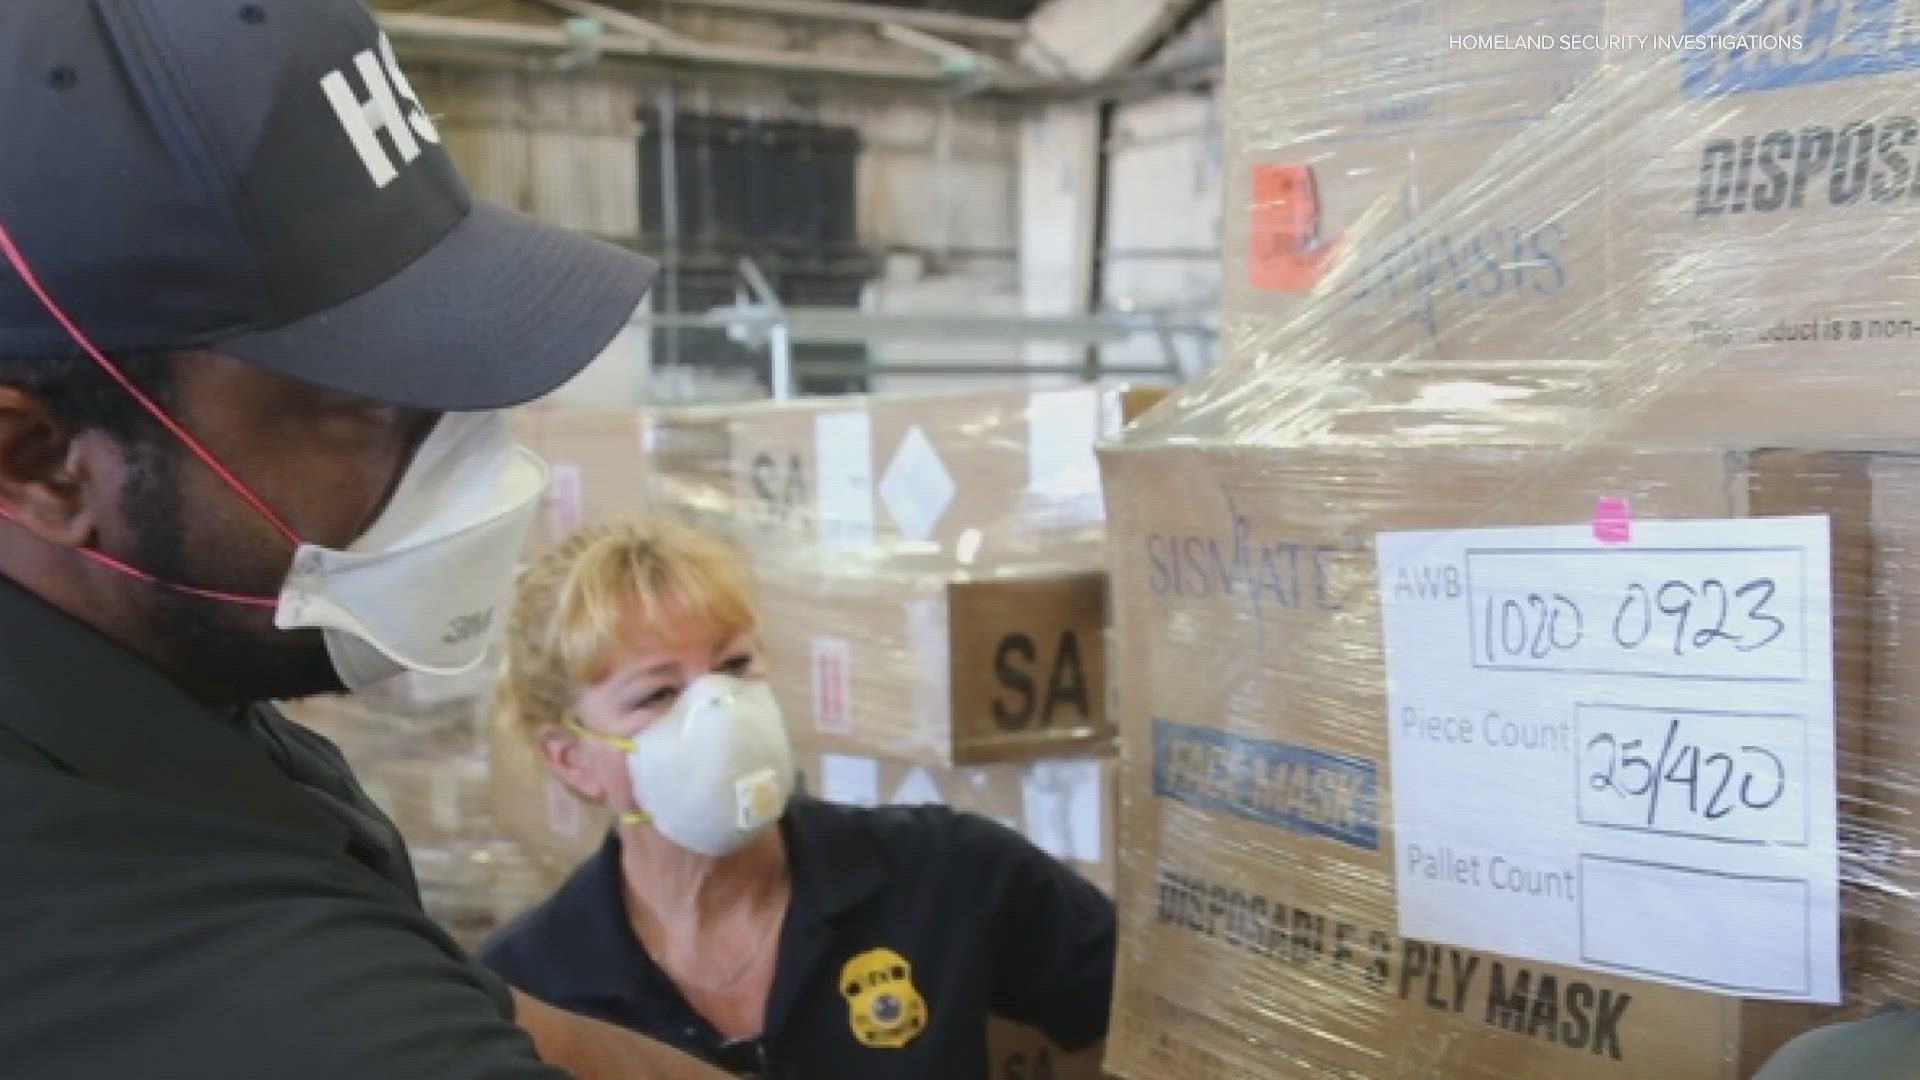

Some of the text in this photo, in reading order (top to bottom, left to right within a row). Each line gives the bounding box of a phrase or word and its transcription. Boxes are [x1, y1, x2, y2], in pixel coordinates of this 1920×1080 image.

[1696, 115, 1920, 216] DISPOS
[1823, 316, 1844, 341] is
[1848, 319, 1863, 341] a
[1395, 564, 1462, 599] AWB
[1485, 577, 1785, 662] 1020 0923
[991, 631, 1089, 733] SA
[1402, 706, 1572, 752] Piece Count
[1586, 719, 1785, 825] 25/420
[1407, 843, 1575, 902] Pallet Count
[1398, 937, 1481, 1013] PLY
[1484, 960, 1633, 1061] MASK
